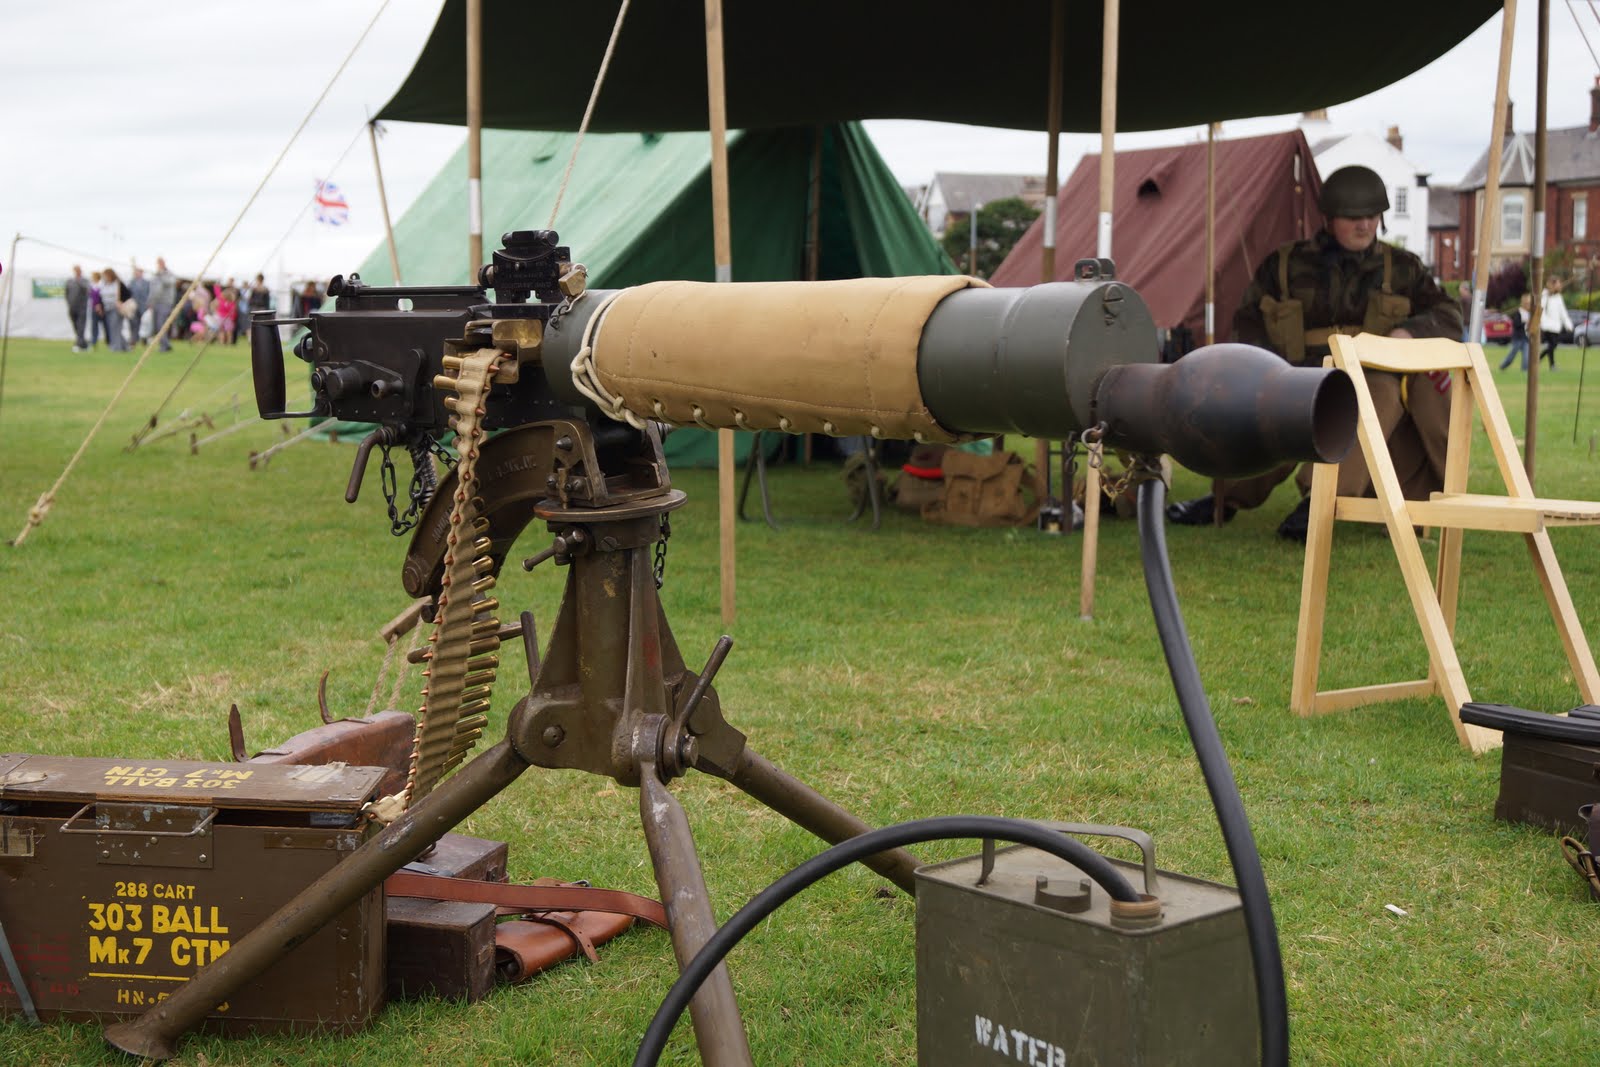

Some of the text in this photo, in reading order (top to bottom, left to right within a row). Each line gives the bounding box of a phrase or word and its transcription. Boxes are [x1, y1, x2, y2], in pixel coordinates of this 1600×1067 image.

[104, 766, 169, 777] CTN
[104, 775, 241, 789] 303 BALL
[115, 881, 195, 899] 288 CART
[88, 902, 229, 934] 303 BALL
[170, 936, 230, 967] CTN
